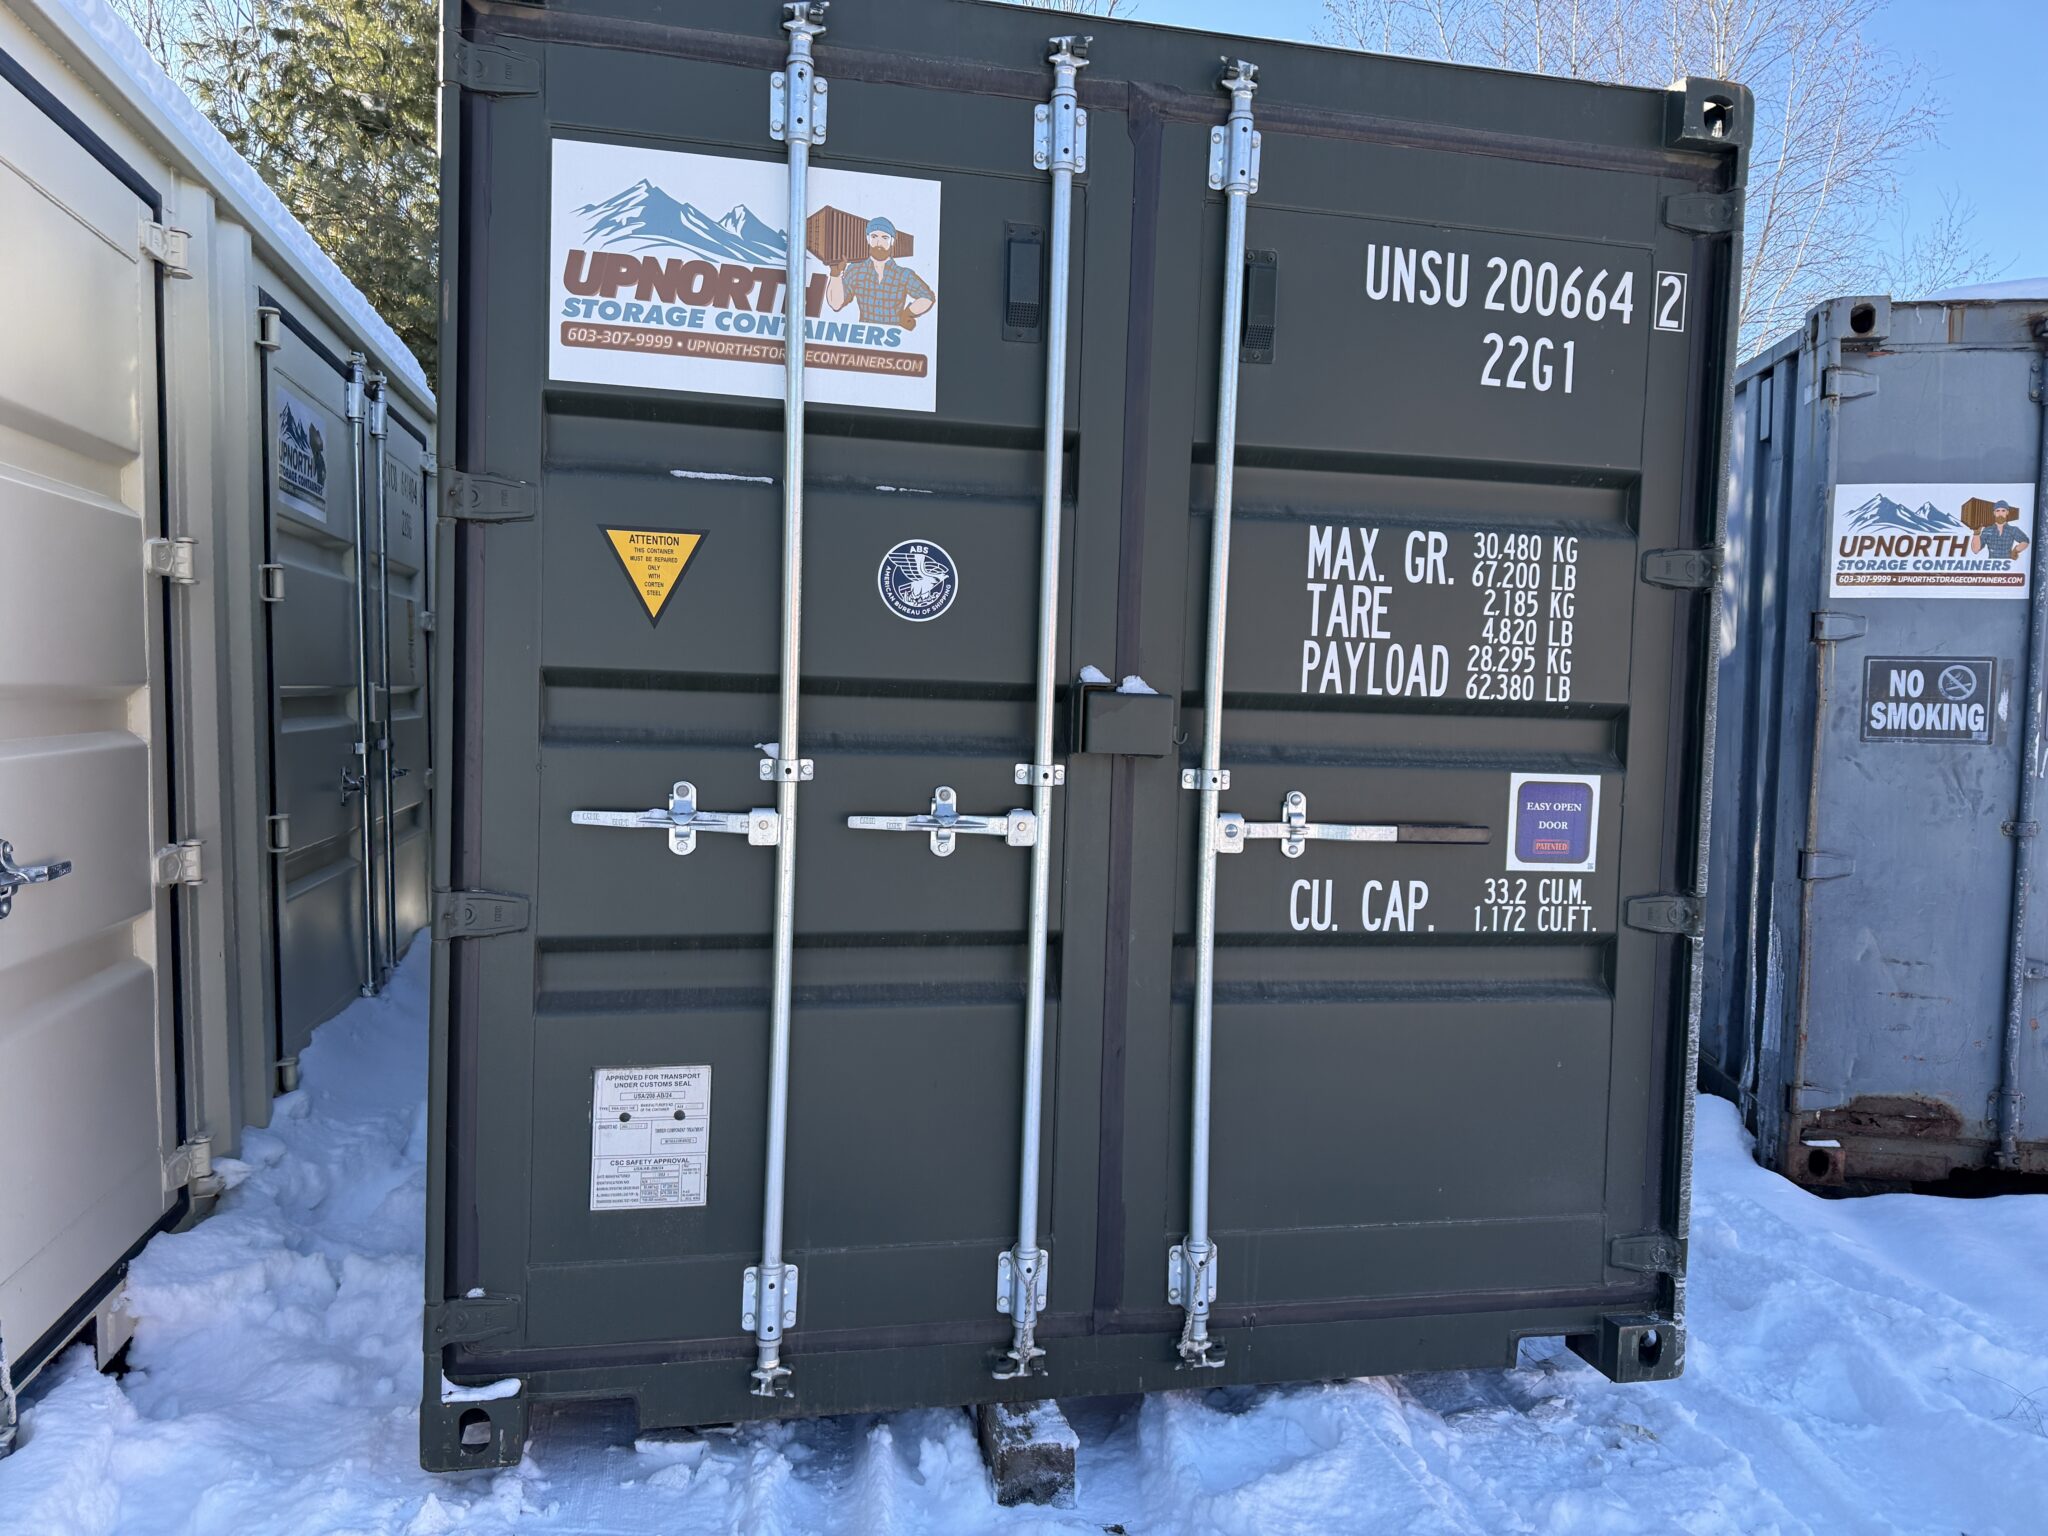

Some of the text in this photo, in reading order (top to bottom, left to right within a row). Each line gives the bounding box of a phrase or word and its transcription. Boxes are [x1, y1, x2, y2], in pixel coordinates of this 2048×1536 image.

[1366, 244, 1682, 328] UNSU 200664 2
[561, 297, 903, 347] STORAGE CONINERS
[567, 327, 924, 372] 603-307-9999 UPNORTHSTORECONTAINERS.COM
[1480, 332, 1575, 394] 22G1
[629, 534, 680, 546] ATTENTION
[909, 546, 929, 554] ABS
[1840, 535, 1971, 558] UPNORTH
[1307, 525, 1578, 585] MAX. GR. 30,480 KG
[1836, 559, 2012, 571] STORAGE CONTAINERS
[884, 566, 895, 602] AMERICAN
[894, 601, 920, 615] BUREAU
[932, 584, 952, 612] SHIPPING
[1472, 561, 1577, 591] 67,200 LB
[1839, 575, 2023, 584] 603-307-9999 UPNORTHSTORAGECONTAINERS.COM
[1306, 583, 1575, 639] TARE 2,185 KG
[1482, 618, 1573, 647] 4,820 LB
[1301, 640, 1572, 697] PAYLOAD 28,295 KG
[1465, 674, 1571, 702] 62,380 LB
[1889, 669, 1924, 698] NO
[1870, 702, 1985, 731] SMOKING
[1526, 802, 1582, 811] EASY OPEN
[1538, 821, 1568, 829] DOOR
[1536, 842, 1568, 850] PATENTED
[1289, 878, 1587, 932] CU. CAP. 33.2 CU.M.
[1474, 905, 1597, 932] 1,172 CU.FT.
